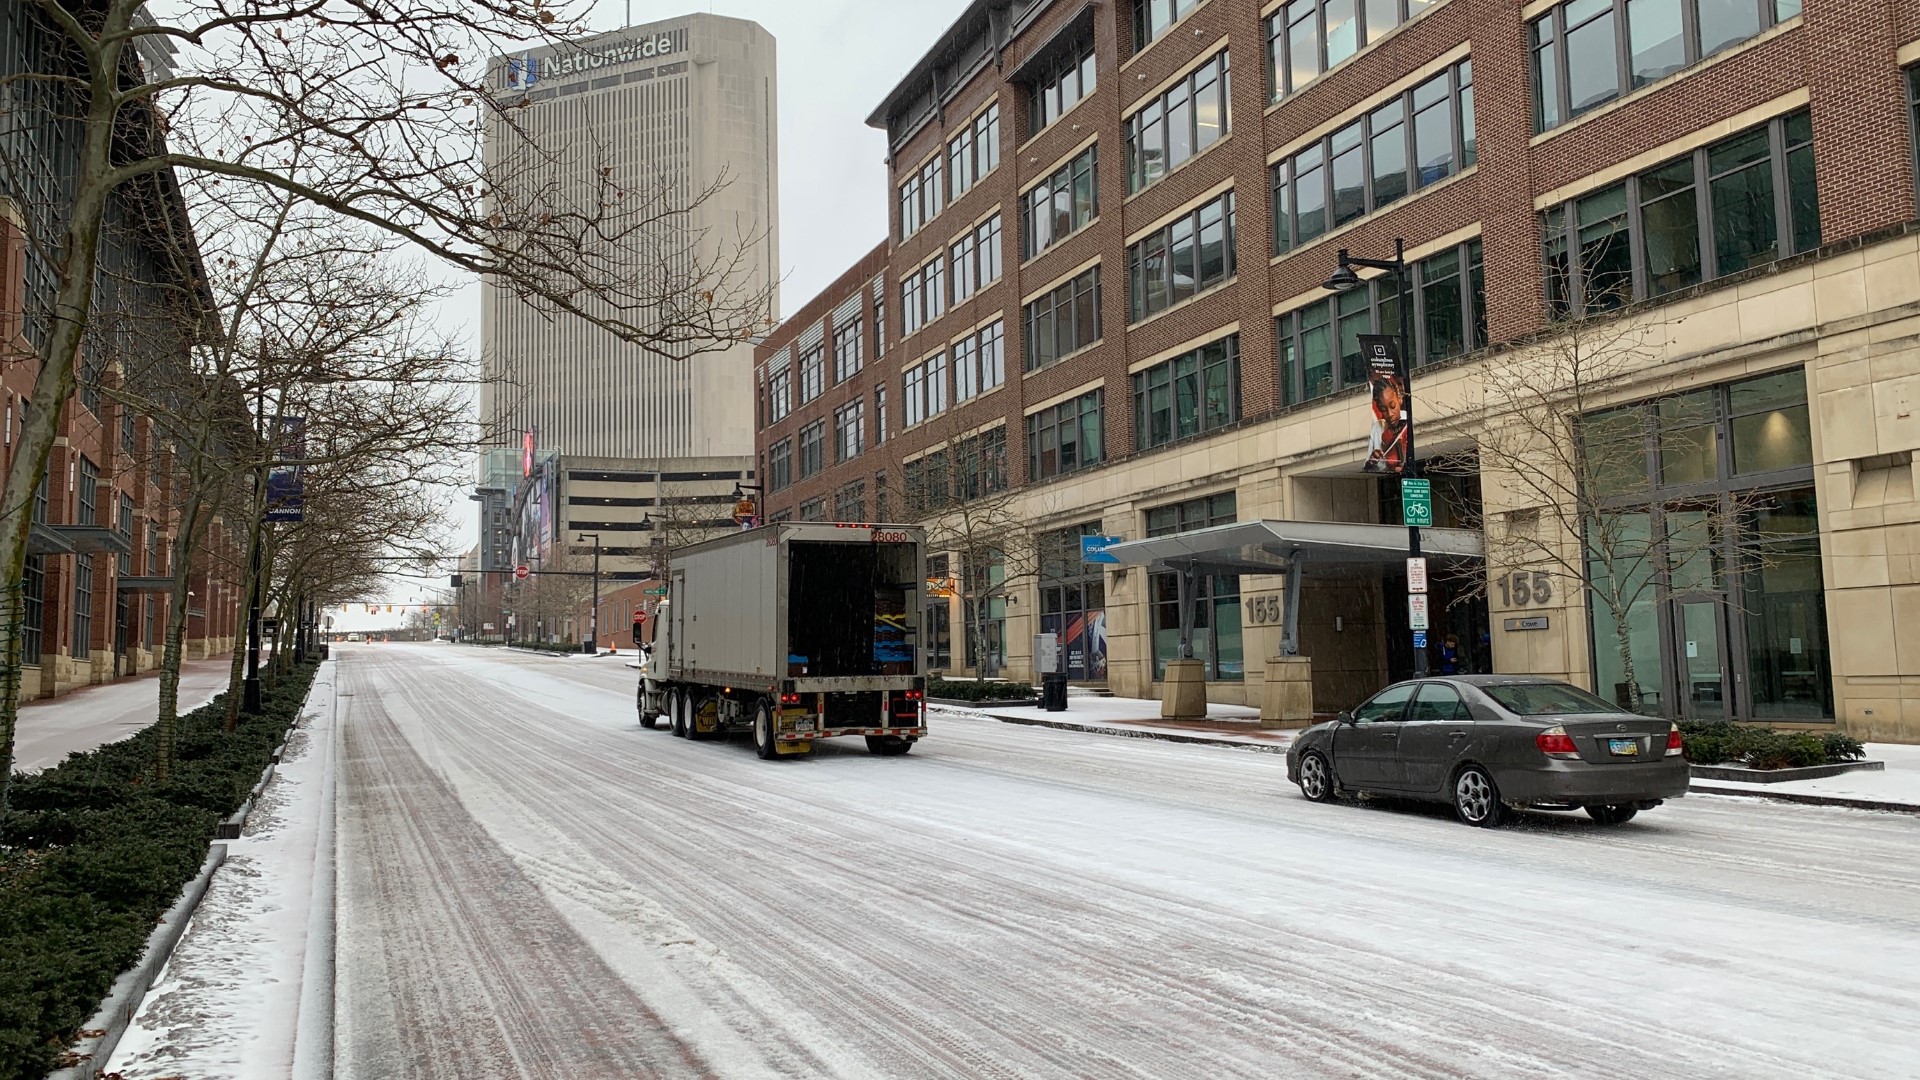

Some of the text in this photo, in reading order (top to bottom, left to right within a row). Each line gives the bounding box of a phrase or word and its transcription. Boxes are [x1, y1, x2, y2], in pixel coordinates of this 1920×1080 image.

[543, 35, 671, 78] Nationwide
[871, 532, 907, 542] 28080
[1497, 570, 1552, 607] 155
[1245, 595, 1280, 624] 155
[1521, 620, 1538, 628] Crowe
